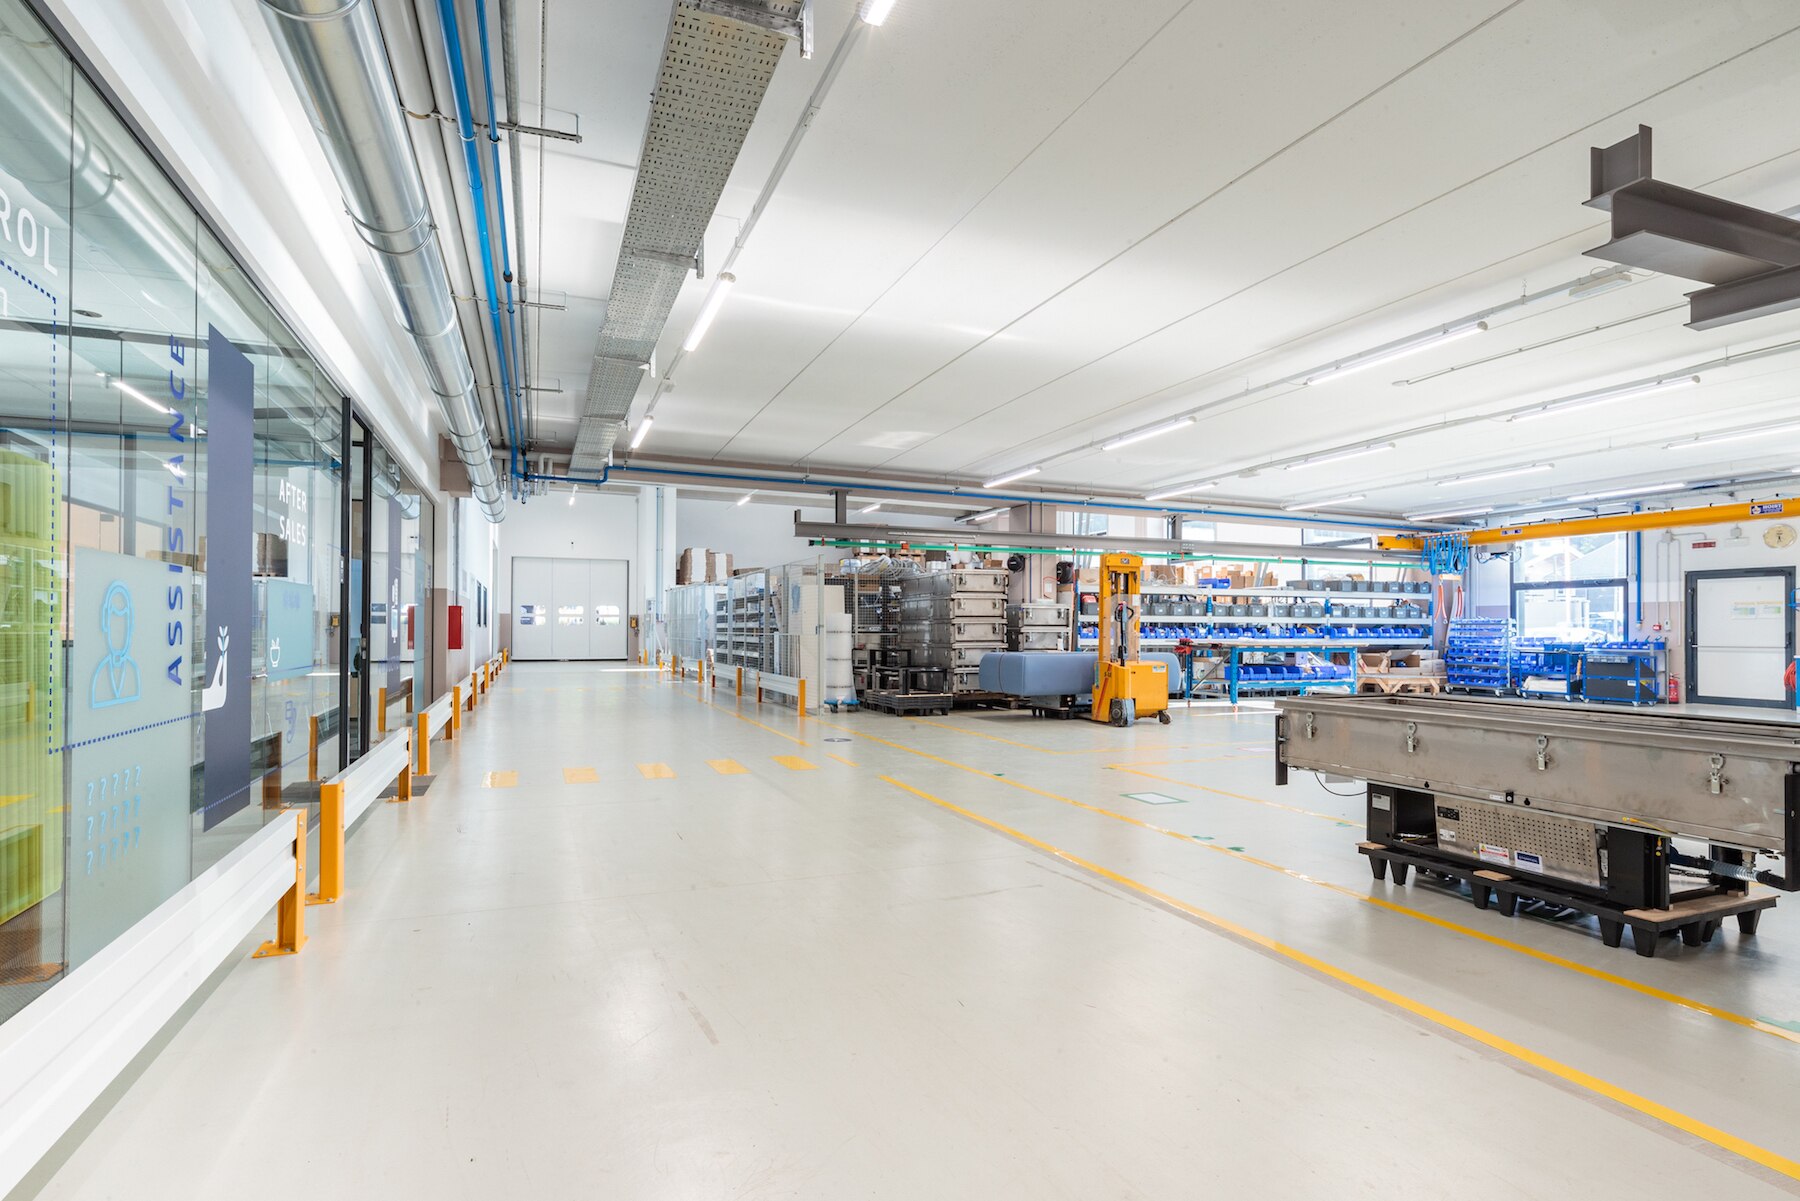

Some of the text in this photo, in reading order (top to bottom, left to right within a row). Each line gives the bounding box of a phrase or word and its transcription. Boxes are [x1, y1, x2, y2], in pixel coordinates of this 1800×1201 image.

[167, 334, 185, 686] ASSISTANCE
[279, 479, 307, 513] AFTER
[279, 515, 306, 547] SALES
